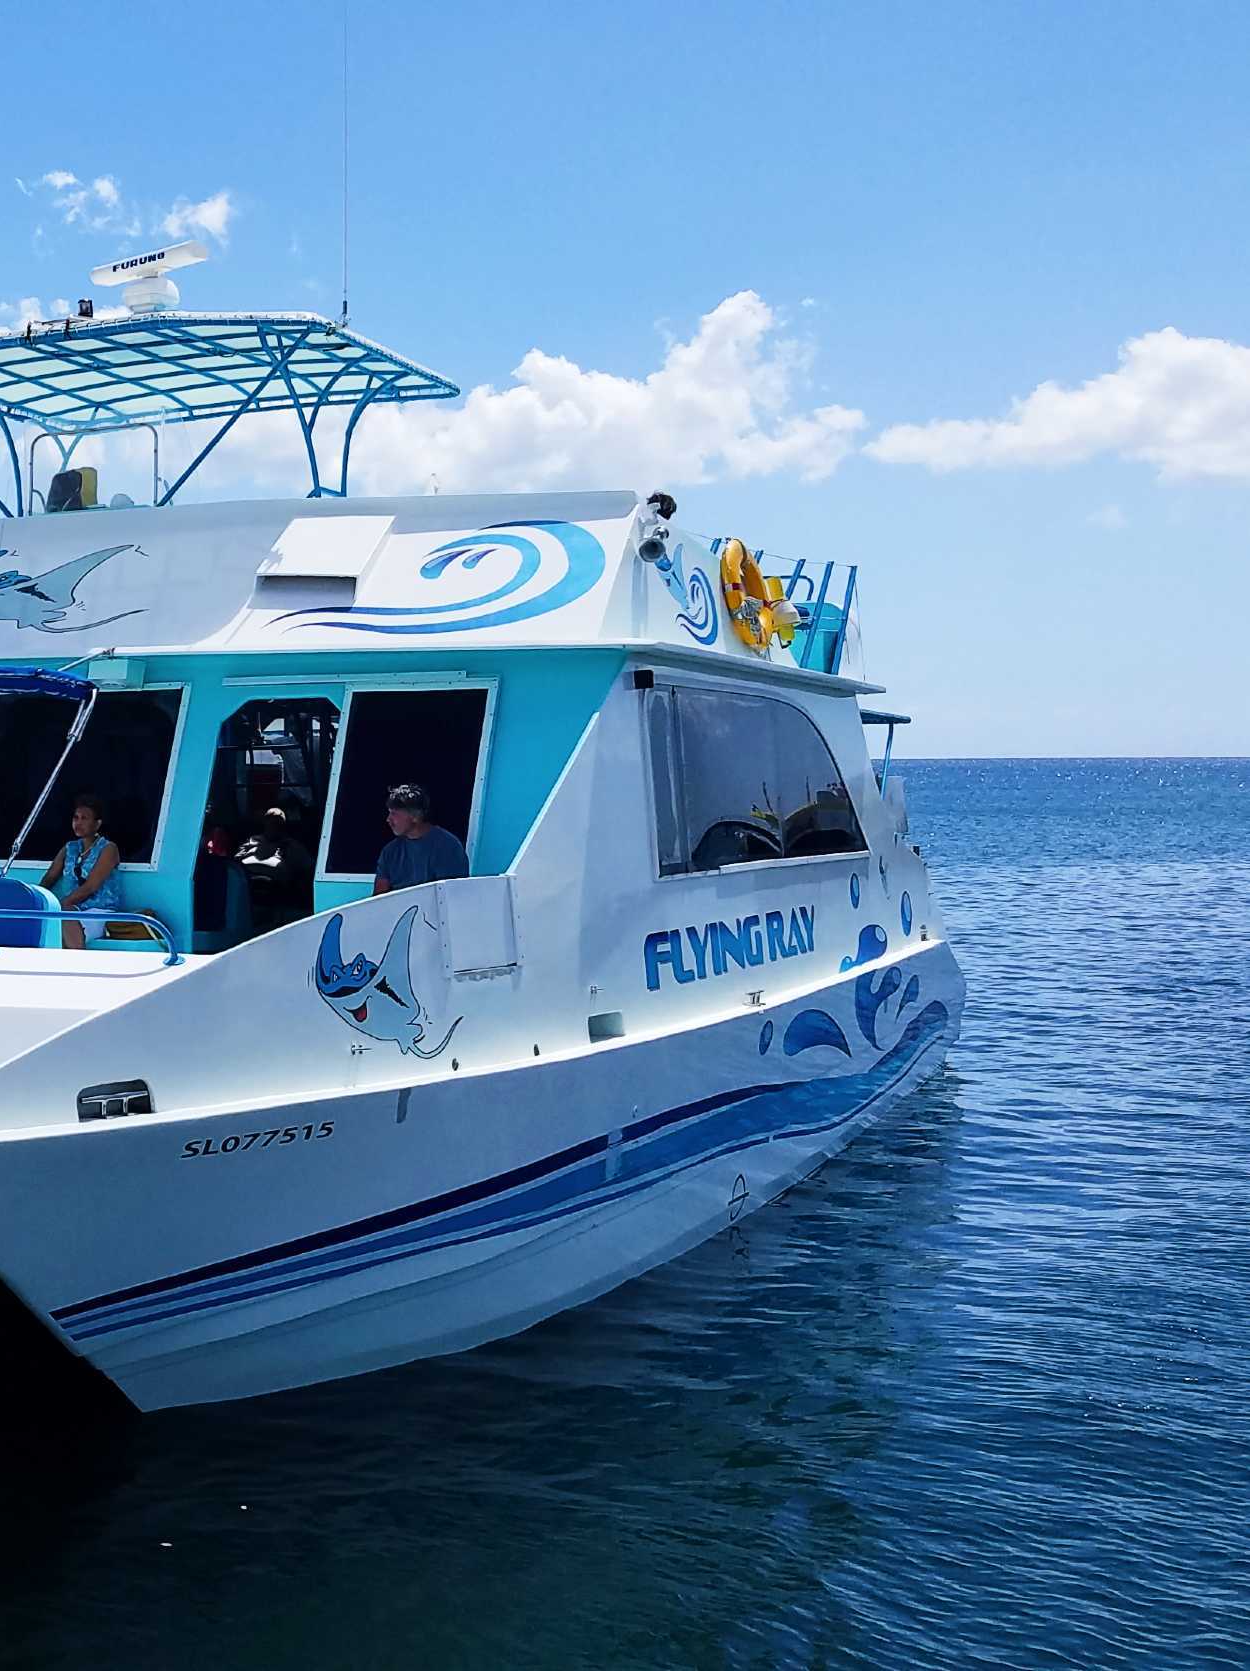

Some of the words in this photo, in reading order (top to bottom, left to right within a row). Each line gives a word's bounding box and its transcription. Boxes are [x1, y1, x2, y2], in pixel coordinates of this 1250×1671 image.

[112, 251, 165, 272] FURUNO
[644, 914, 764, 991] FLYING
[765, 904, 815, 962] RAY
